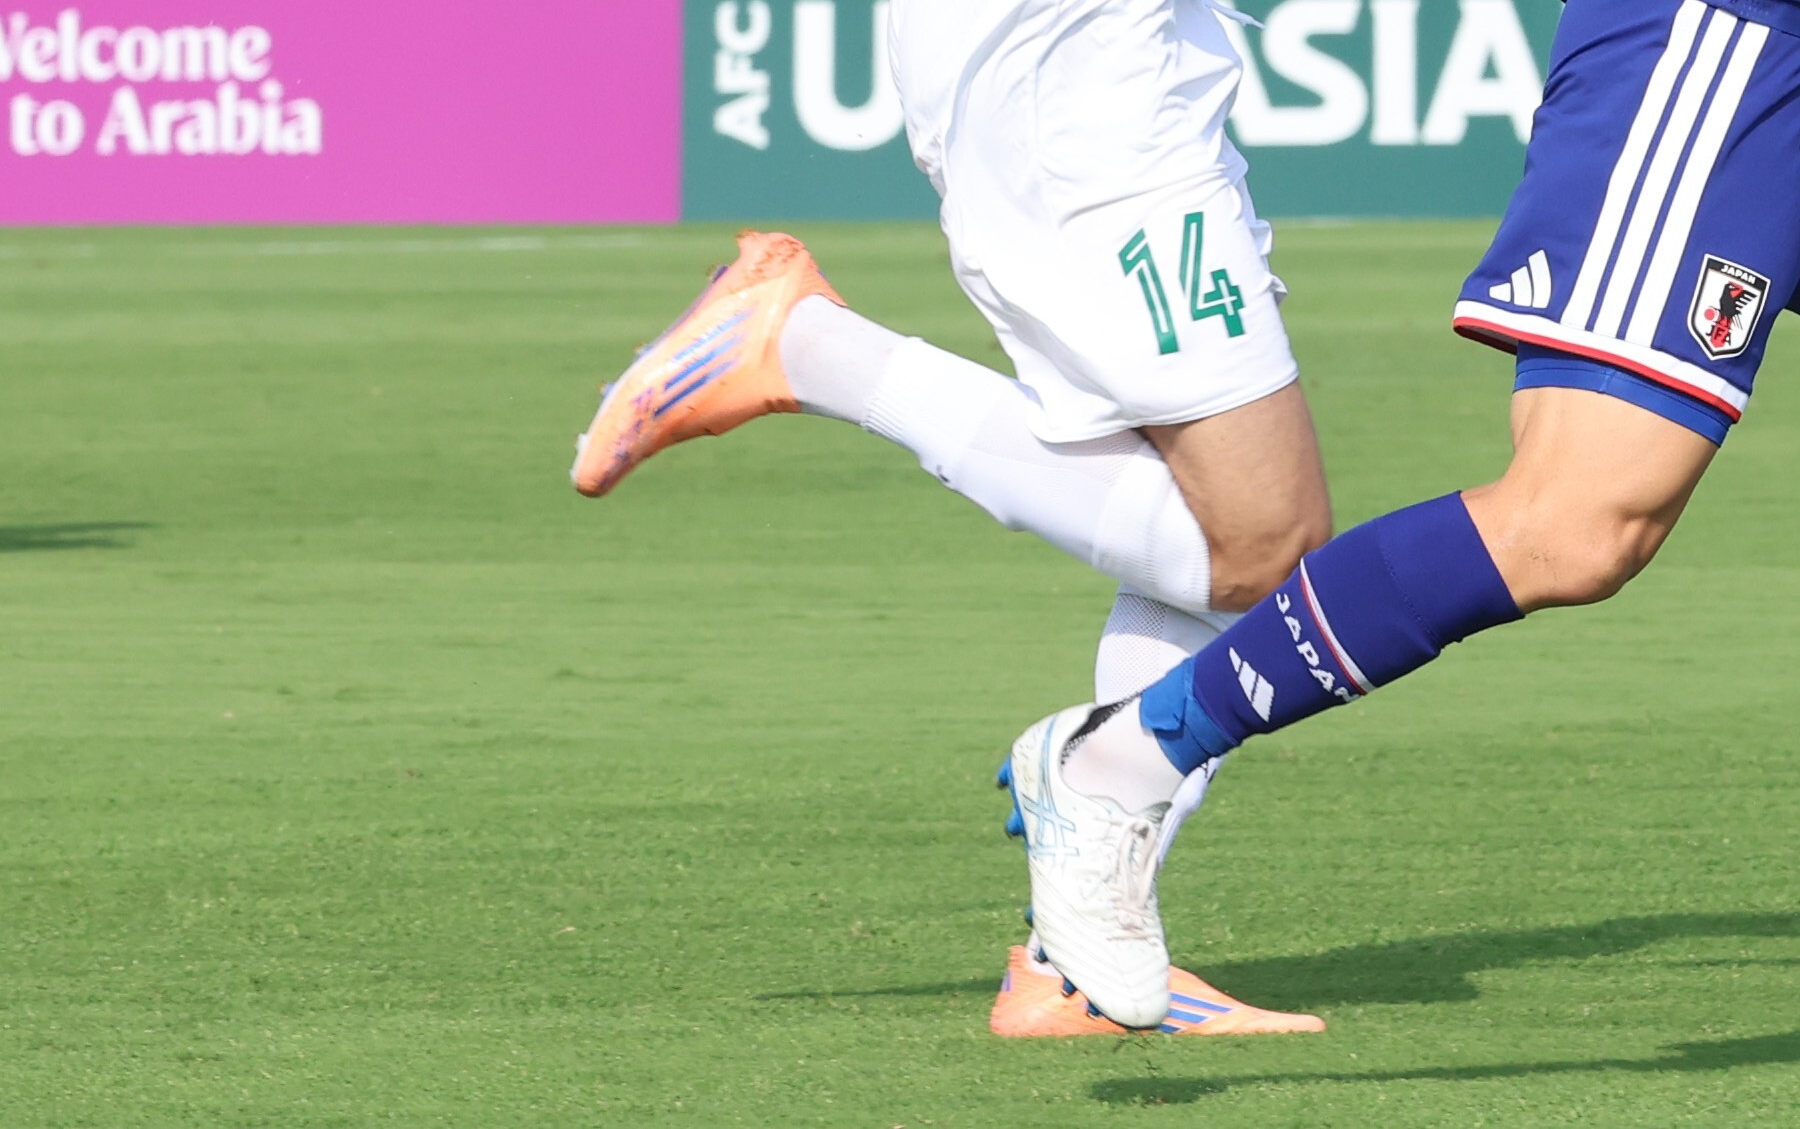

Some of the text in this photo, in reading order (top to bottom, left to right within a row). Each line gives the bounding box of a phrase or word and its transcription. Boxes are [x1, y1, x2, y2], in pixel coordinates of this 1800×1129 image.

[9, 78, 323, 156] to Arabia
[1118, 210, 1246, 356] 14
[1720, 264, 1757, 285] JAPAN
